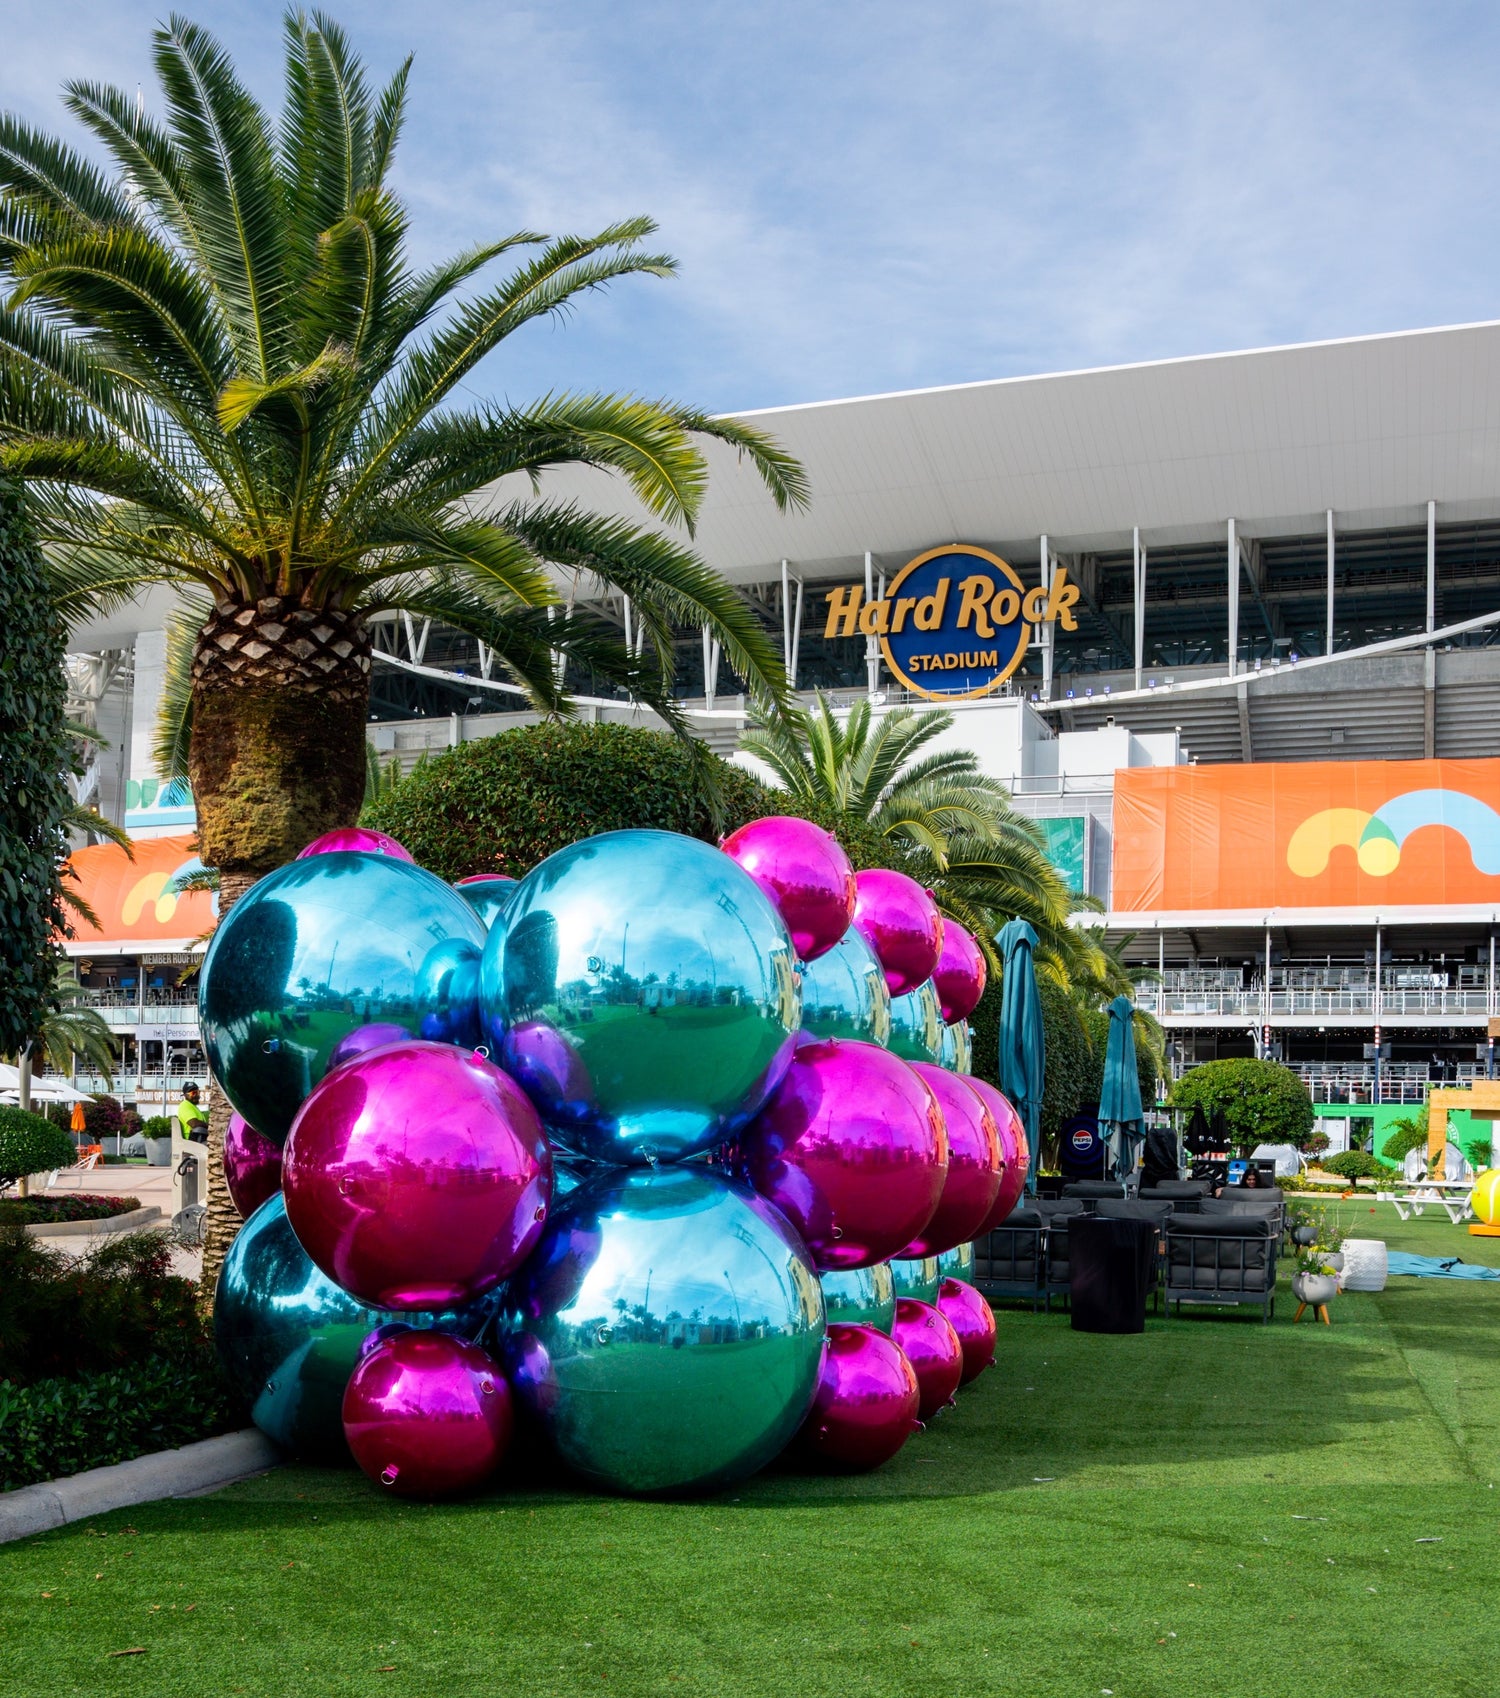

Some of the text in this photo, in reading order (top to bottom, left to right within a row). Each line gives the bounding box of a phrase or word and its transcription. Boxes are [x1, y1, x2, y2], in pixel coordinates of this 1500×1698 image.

[823, 567, 1080, 639] Hard Rock
[908, 650, 998, 672] STADIUM
[142, 953, 172, 965] MEMBER
[154, 1091, 170, 1101] OPN
